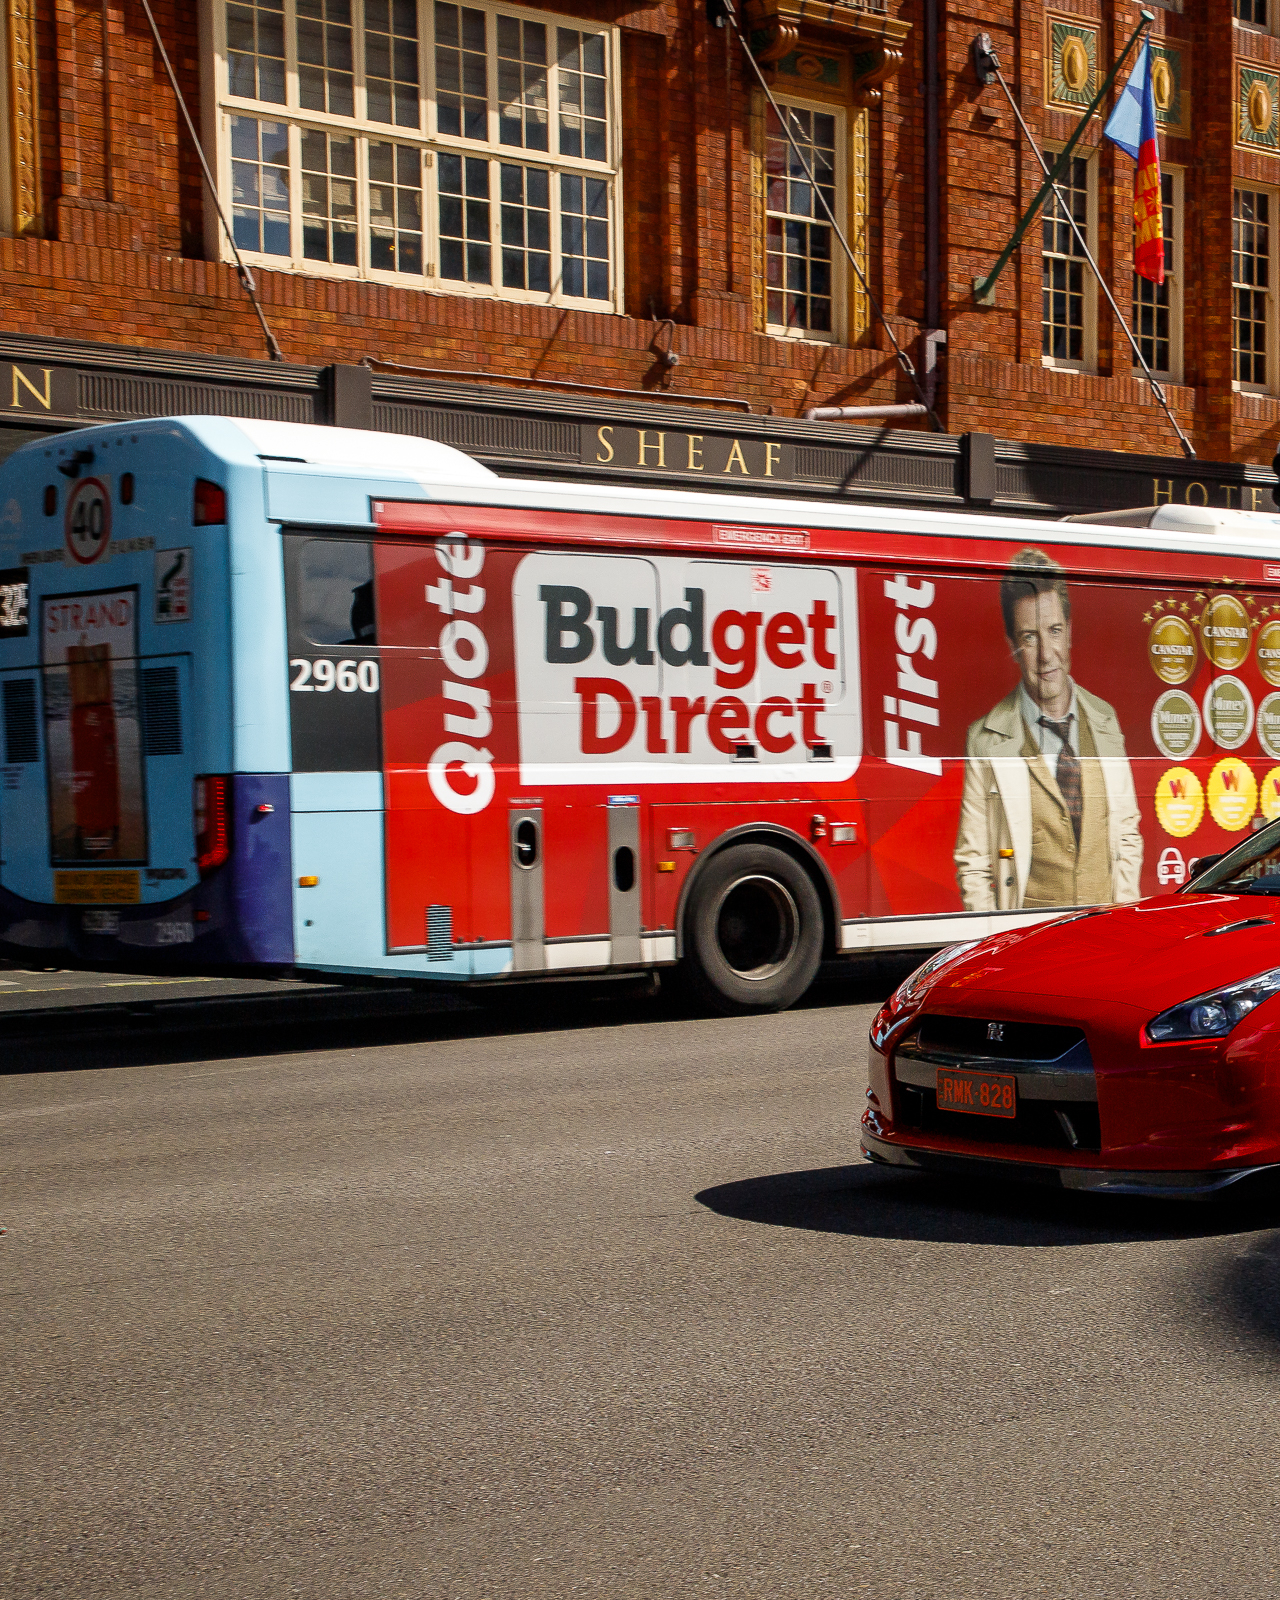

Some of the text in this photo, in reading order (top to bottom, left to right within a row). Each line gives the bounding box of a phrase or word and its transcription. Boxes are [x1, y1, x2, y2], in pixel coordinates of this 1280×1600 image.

[11, 365, 53, 410] N
[596, 426, 1263, 510] SHEAF HOTE
[72, 499, 103, 541] 40
[719, 529, 781, 543] EMERGENCY
[47, 599, 131, 634] STRAND
[538, 584, 837, 690] Budget
[1204, 626, 1249, 639] CANSTAR
[1151, 644, 1194, 656] CANSTAR
[289, 657, 380, 695] 2960
[426, 531, 496, 815] Quote
[883, 572, 943, 776] First
[574, 677, 827, 755] Direct
